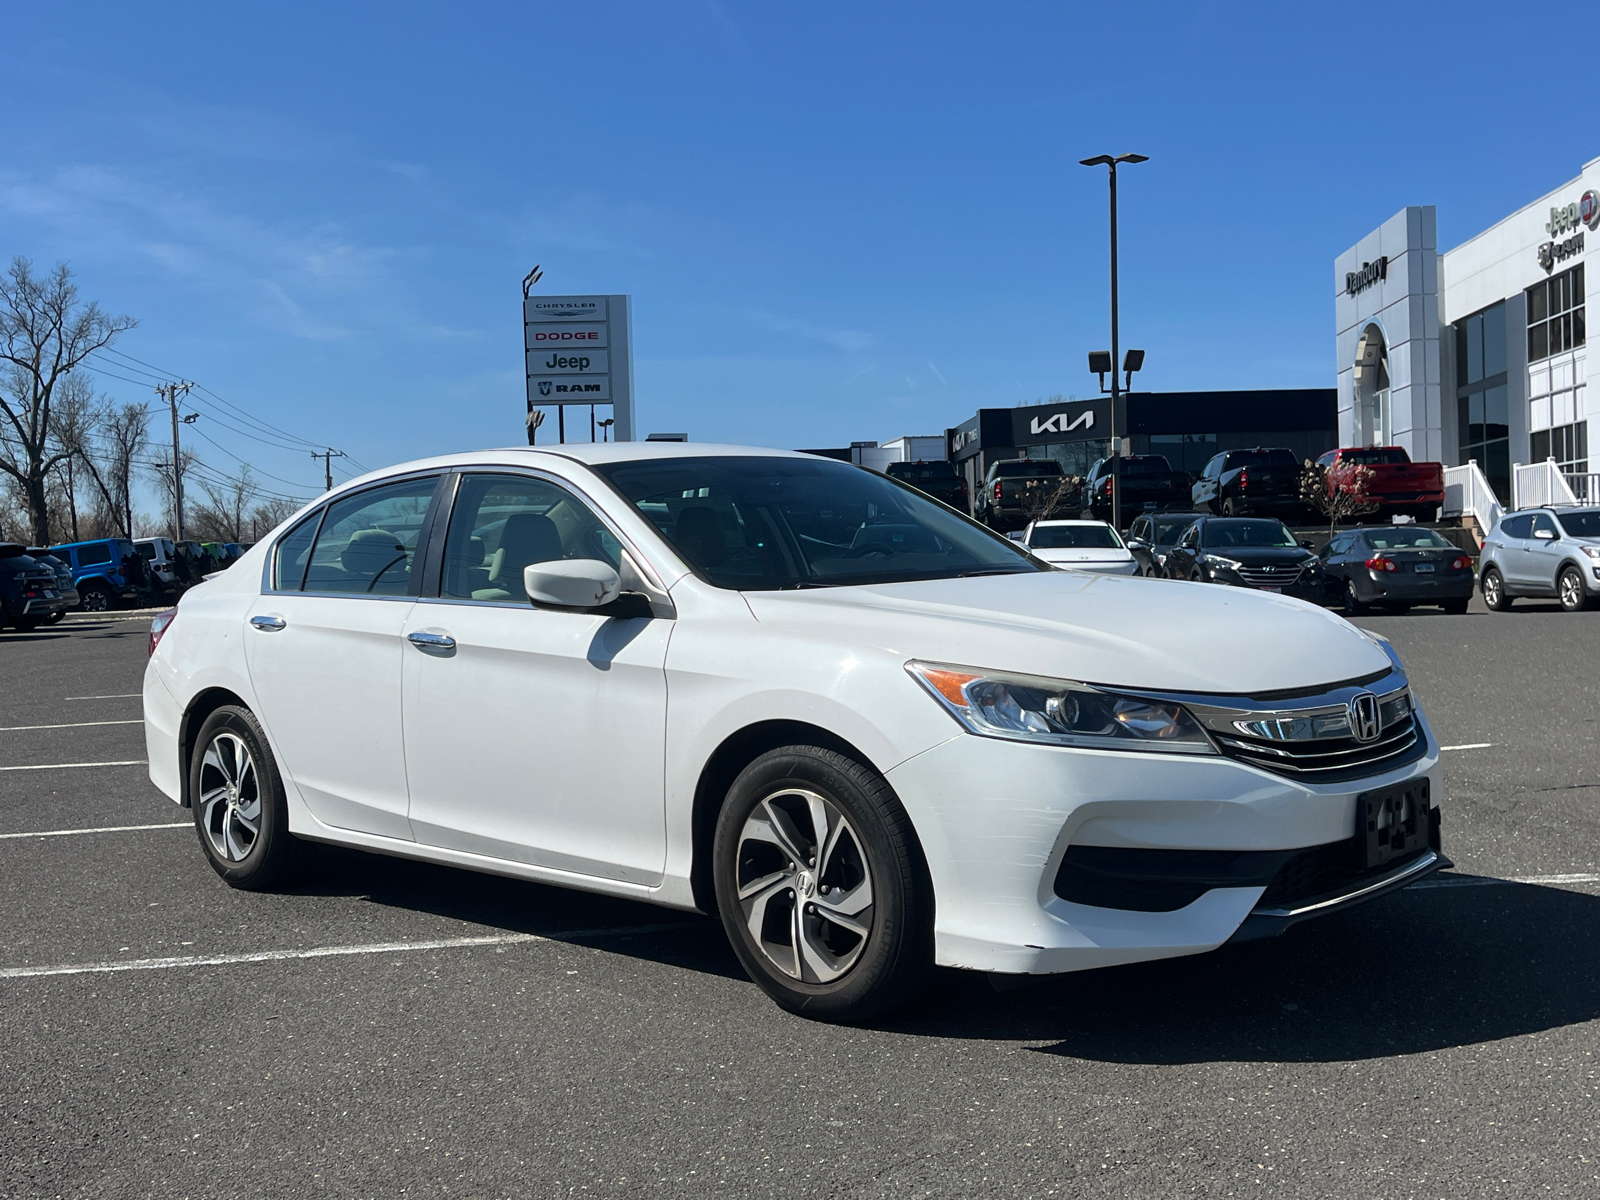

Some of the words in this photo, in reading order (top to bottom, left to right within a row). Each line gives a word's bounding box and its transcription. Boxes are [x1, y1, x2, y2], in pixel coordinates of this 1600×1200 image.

[1545, 202, 1578, 233] Jeep
[1551, 231, 1584, 260] RAM
[1346, 256, 1388, 296] Danbury
[535, 332, 599, 341] DODGE
[545, 353, 590, 371] Jeep
[556, 384, 600, 392] RAM
[1030, 410, 1094, 435] KIA
